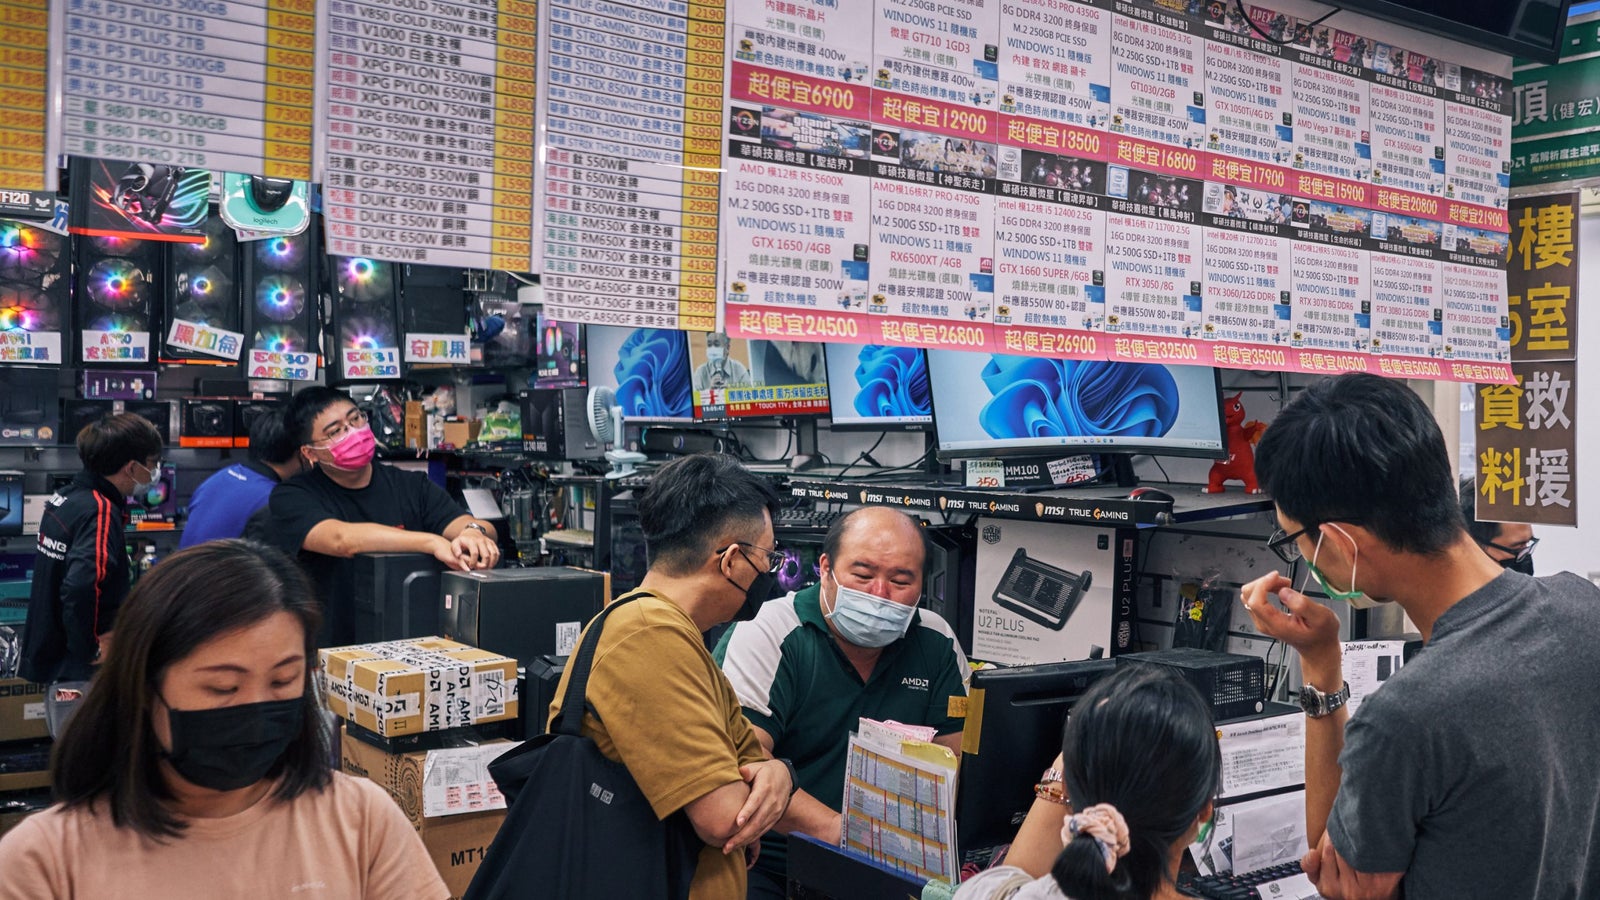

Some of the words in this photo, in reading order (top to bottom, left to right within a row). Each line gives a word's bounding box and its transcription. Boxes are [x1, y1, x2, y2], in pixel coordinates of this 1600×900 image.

[1252, 9, 1271, 23] APEX
[362, 24, 405, 41] V1000
[504, 51, 533, 63] 6990
[912, 32, 941, 47] GT710
[946, 40, 970, 54] 1GD3
[1337, 33, 1353, 45] APEX
[576, 45, 606, 59] STRIX
[610, 51, 639, 66] 650W
[694, 68, 721, 78] 3790
[1013, 54, 1030, 67] 內建
[1410, 53, 1426, 65] APEX
[130, 67, 170, 84] PLUS
[176, 74, 204, 89] 1TB
[748, 71, 854, 110] 超便宜6900
[1130, 81, 1176, 99] GT1030/2GB
[104, 103, 134, 119] 980
[138, 107, 173, 123] PRO
[177, 113, 227, 130] 500GB
[794, 116, 831, 129] grand
[883, 97, 987, 135] 超便宜12900
[1008, 119, 1100, 154] 超便宜13500
[1118, 140, 1196, 172] 超便宜16800
[360, 160, 427, 178] GP-P550B
[501, 177, 531, 189] 1590
[740, 164, 765, 174] AMD
[801, 172, 812, 182] R5
[816, 174, 843, 186] 5600X
[1212, 159, 1285, 188] 超便宜17900
[735, 181, 755, 191] 16G
[758, 184, 785, 195] DDR4
[788, 187, 810, 199] 3200
[936, 191, 952, 200] PRO
[955, 194, 980, 205] 4750G
[1298, 175, 1365, 202] 超便宜15900
[360, 194, 397, 207] DUKE
[401, 198, 438, 211] 450W
[500, 210, 531, 222] 1190
[728, 197, 749, 209] M.2
[752, 200, 779, 213] 500G
[783, 204, 830, 220] SSD+1TB
[1378, 189, 1438, 216] 超便宜20800
[254, 217, 278, 225] logitech
[737, 216, 796, 233] WINDOWS
[800, 224, 811, 234] 11
[1449, 204, 1503, 227] 超便宜21900
[582, 217, 626, 231] RM550X
[689, 230, 716, 241] 3290
[752, 237, 774, 248] GTX
[777, 240, 802, 251] 1650
[805, 242, 831, 254] /4GB
[891, 252, 937, 266] RX6500XT
[940, 255, 962, 269] /4GB
[581, 264, 625, 277] RM850X
[688, 275, 714, 285] 4590
[1000, 263, 1017, 274] GTX
[1021, 265, 1041, 276] 1660
[1043, 268, 1069, 279] SUPER
[1071, 271, 1089, 281] /6GB
[1126, 277, 1140, 287] RTX
[1142, 279, 1159, 289] 3050
[1161, 280, 1174, 290] /8G
[739, 310, 858, 338] 超便宜24500
[881, 320, 985, 346] 超便宜26800
[1004, 330, 1097, 355] 超便宜26900
[1114, 338, 1198, 360] 超便宜32500
[1213, 345, 1285, 366] 超便宜35900
[1300, 352, 1367, 372] 超便宜40500
[1379, 358, 1441, 377] 超便宜50500
[1451, 363, 1509, 381] 超便宜57800
[1006, 465, 1039, 475] MM100
[976, 476, 998, 487] 350
[792, 488, 806, 496] msi
[825, 489, 848, 499] GAMING
[867, 493, 883, 502] msi
[886, 496, 902, 504] TRUE
[904, 496, 931, 506] GAMING
[947, 499, 965, 508] msi
[969, 502, 987, 510] TRUE
[989, 501, 1019, 512] GAMING
[1045, 506, 1065, 516] msi
[1069, 508, 1091, 517] TRUE
[1094, 508, 1128, 520] GAMING
[1123, 556, 1133, 592] PLUS
[1122, 596, 1131, 616] U2
[979, 615, 992, 628] U2
[996, 617, 1024, 632] PLUS
